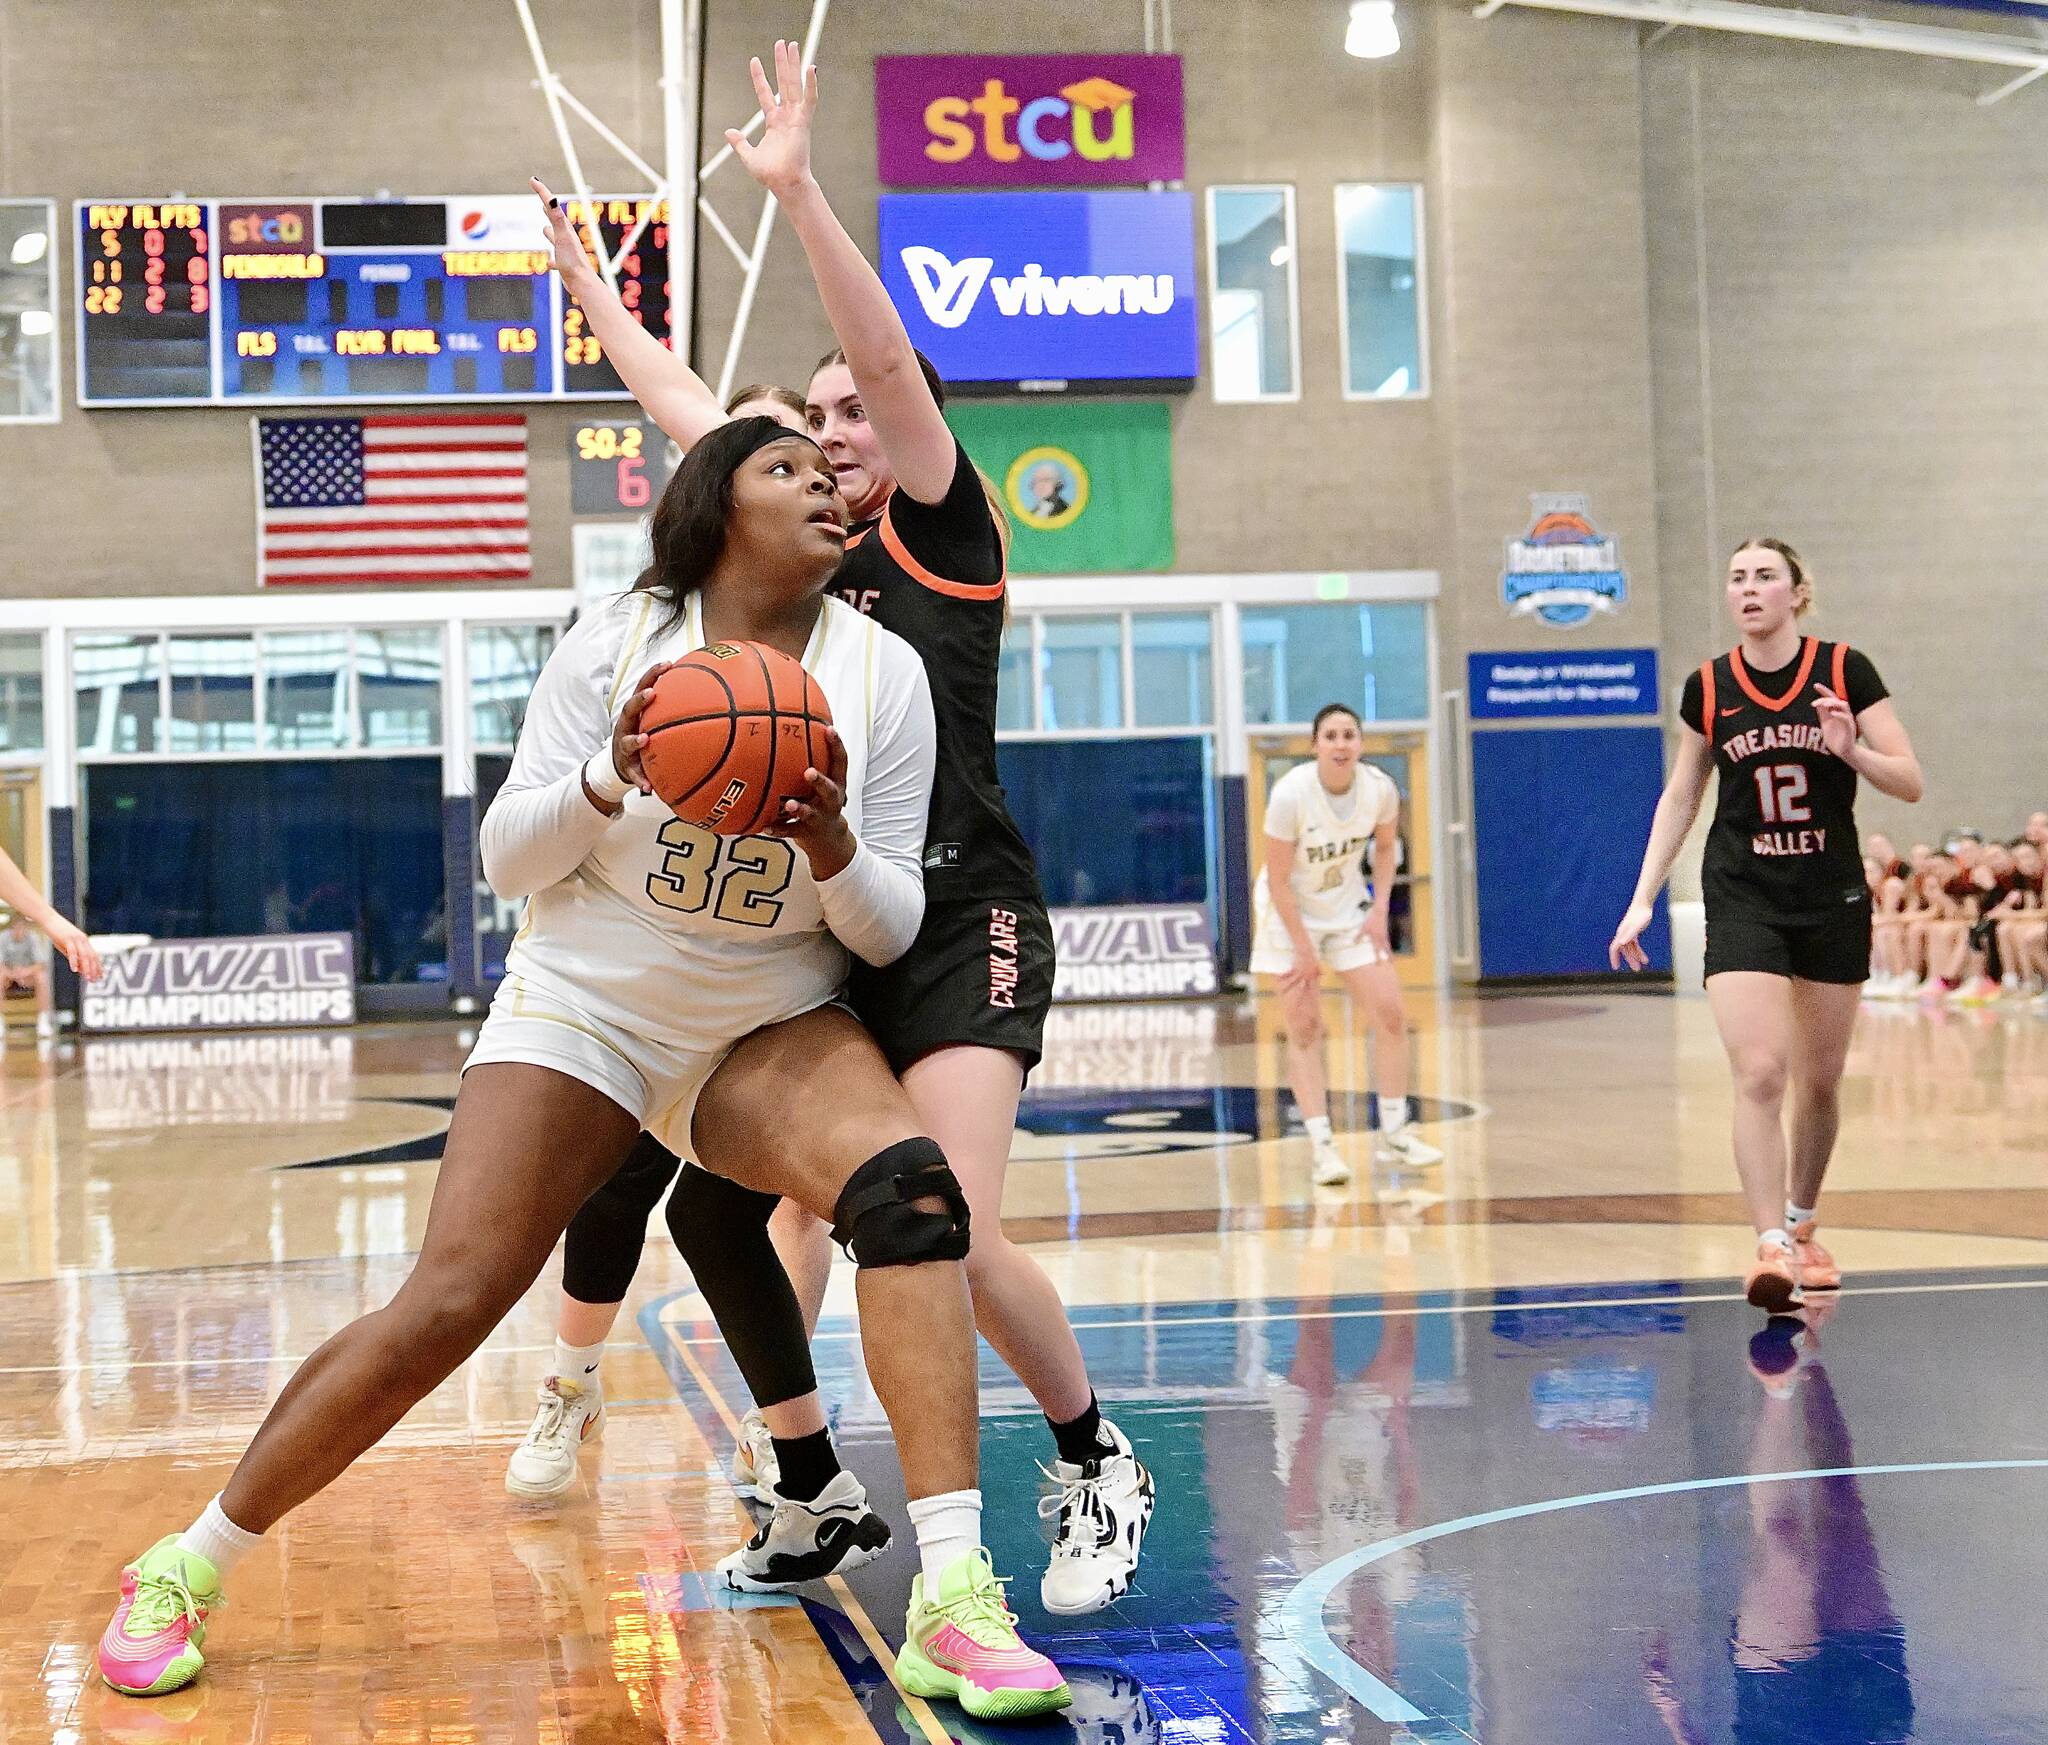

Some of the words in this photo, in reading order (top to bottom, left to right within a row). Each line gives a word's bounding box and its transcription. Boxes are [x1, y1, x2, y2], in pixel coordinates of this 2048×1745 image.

[924, 78, 1136, 162] stcu
[101, 229, 121, 257] 5
[144, 229, 164, 257] 0
[228, 211, 304, 244] stcu
[93, 259, 122, 283] 11
[145, 257, 165, 285] 2
[990, 263, 1174, 316] vivenu
[85, 286, 123, 314] 22
[145, 285, 165, 314] 2
[190, 285, 208, 314] 3
[622, 280, 641, 308] 2
[565, 336, 601, 364] 23
[576, 427, 643, 459] 50.2
[617, 456, 650, 507] 6
[1722, 723, 1830, 763] TREASUR
[1753, 764, 1812, 823] 12
[646, 816, 796, 928] 32
[947, 849, 958, 860] M
[85, 939, 349, 996] NWAC
[989, 908, 1018, 1009] CHUKARS
[83, 989, 353, 1028] CHAMPIONSHIPS
